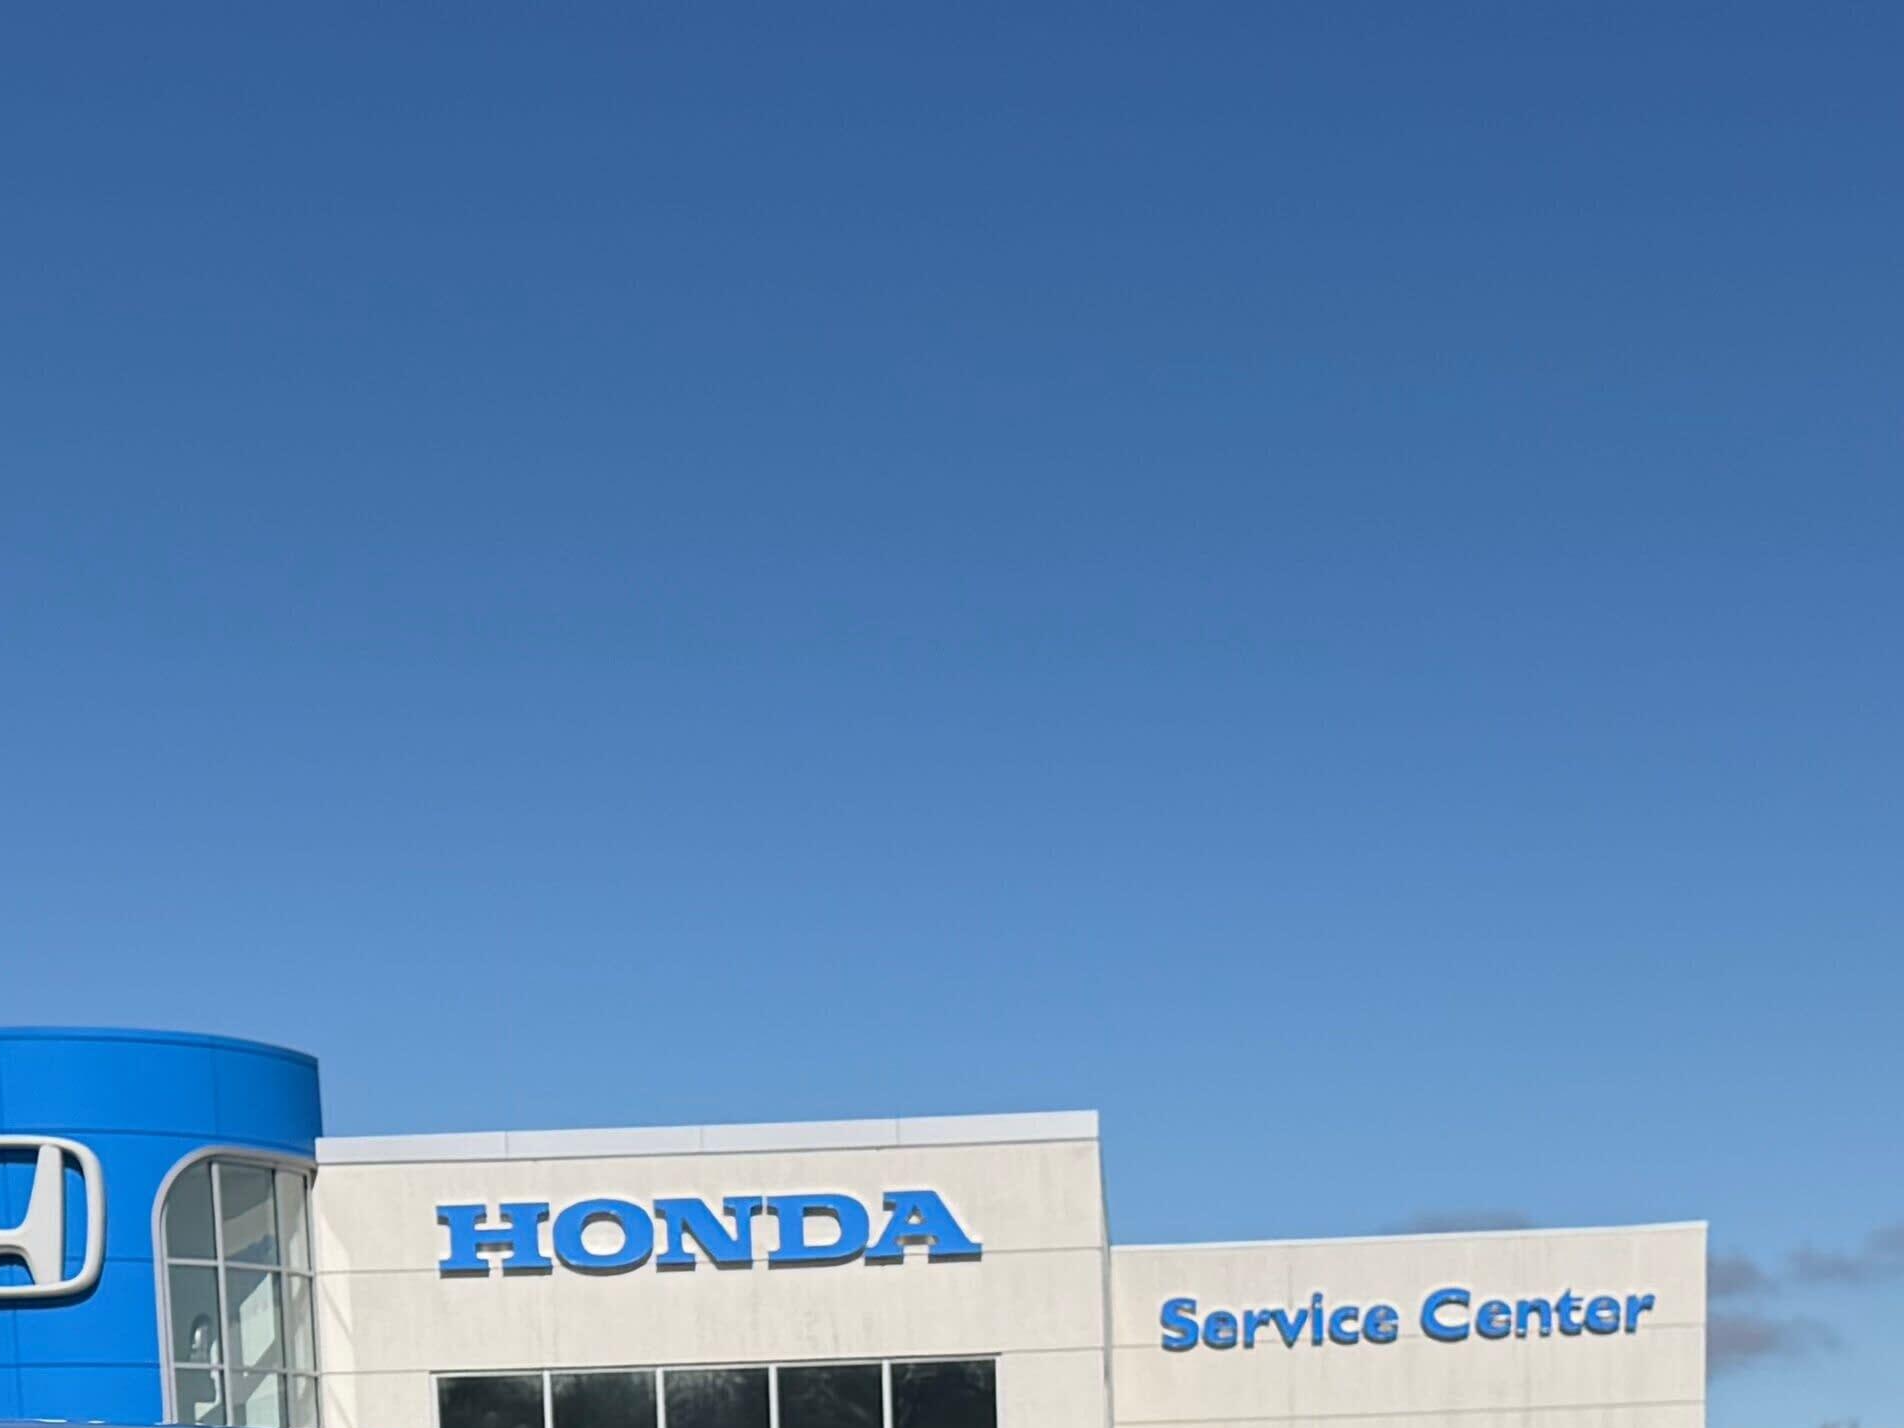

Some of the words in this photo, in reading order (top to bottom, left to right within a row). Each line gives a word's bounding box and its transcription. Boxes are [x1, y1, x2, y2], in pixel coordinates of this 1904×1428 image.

[436, 1189, 982, 1275] HONDA
[1160, 1291, 1399, 1350] Service
[1420, 1286, 1655, 1341] Center
